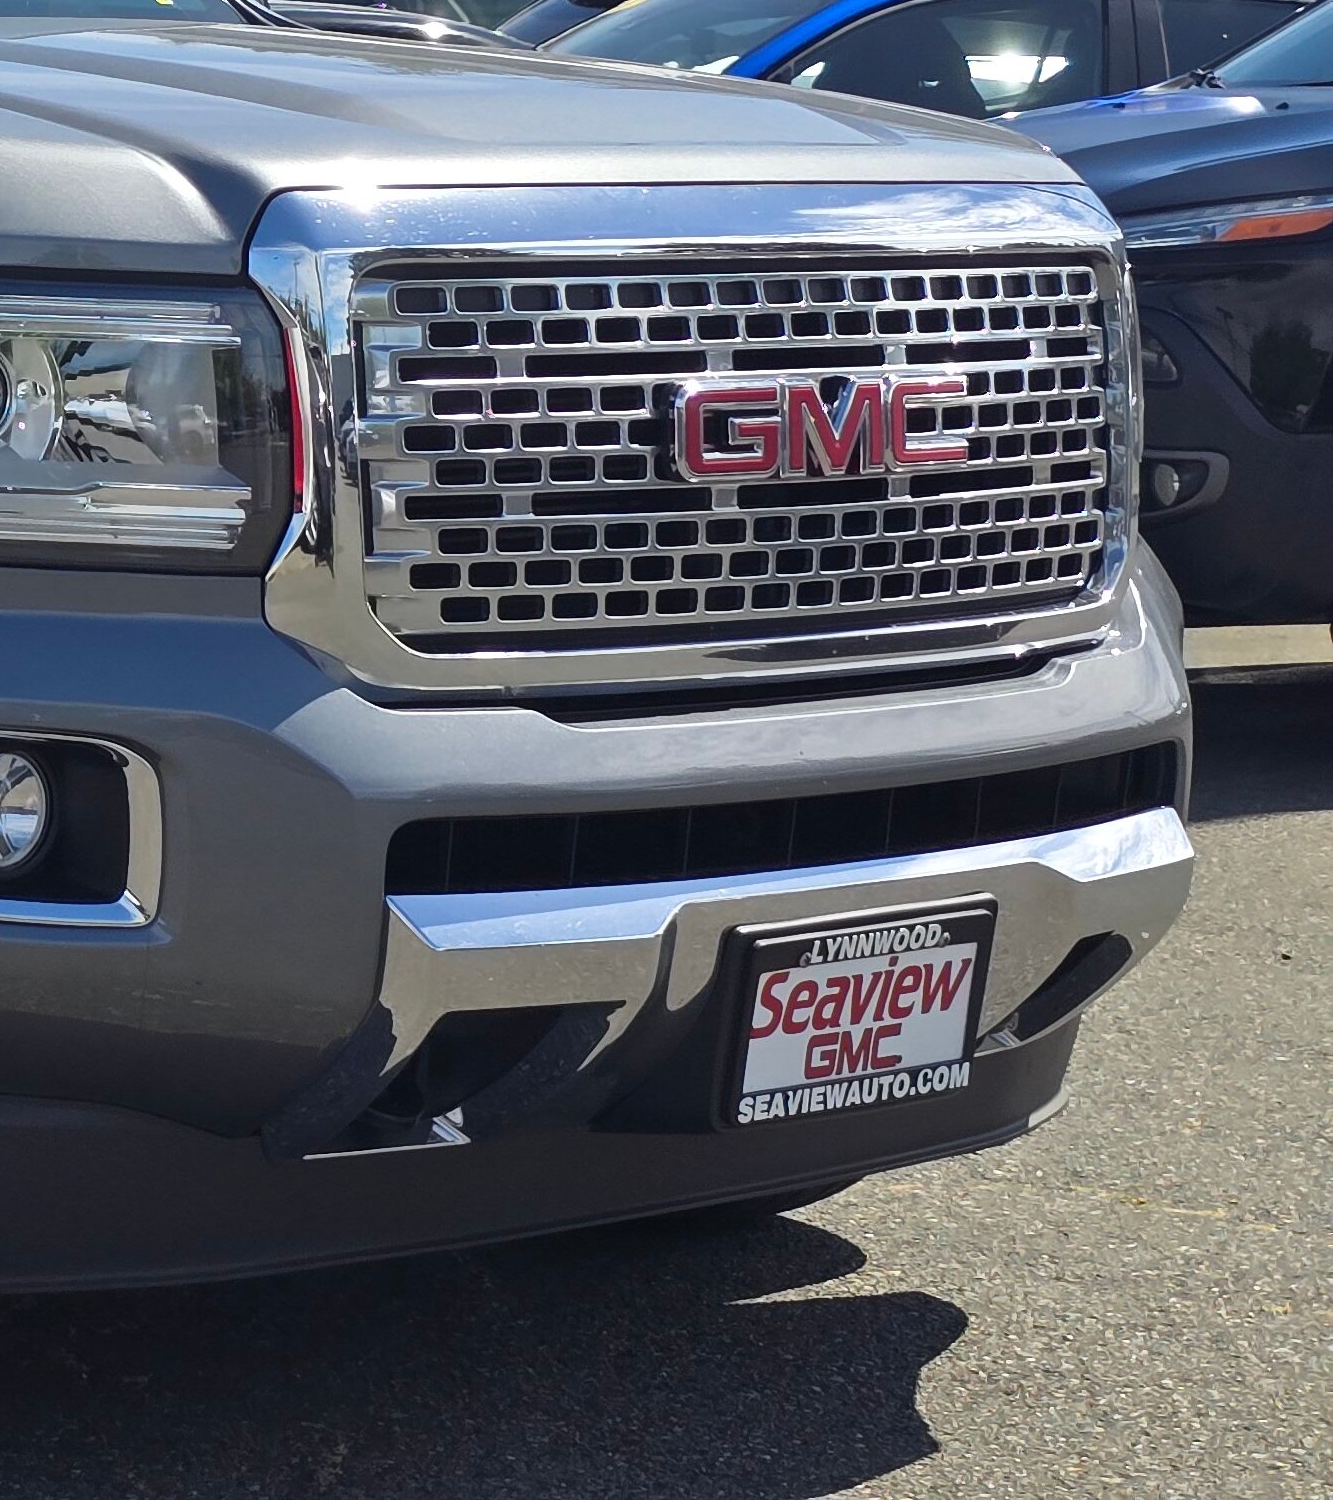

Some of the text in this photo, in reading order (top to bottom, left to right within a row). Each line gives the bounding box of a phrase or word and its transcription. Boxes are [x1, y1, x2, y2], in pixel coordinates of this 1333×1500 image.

[675, 374, 970, 482] GMC
[810, 923, 943, 964] LYNNWOOD
[749, 956, 973, 1039] Seaview
[804, 1022, 903, 1080] GMC
[737, 1062, 970, 1124] SEAVIEWAUTO.COM
